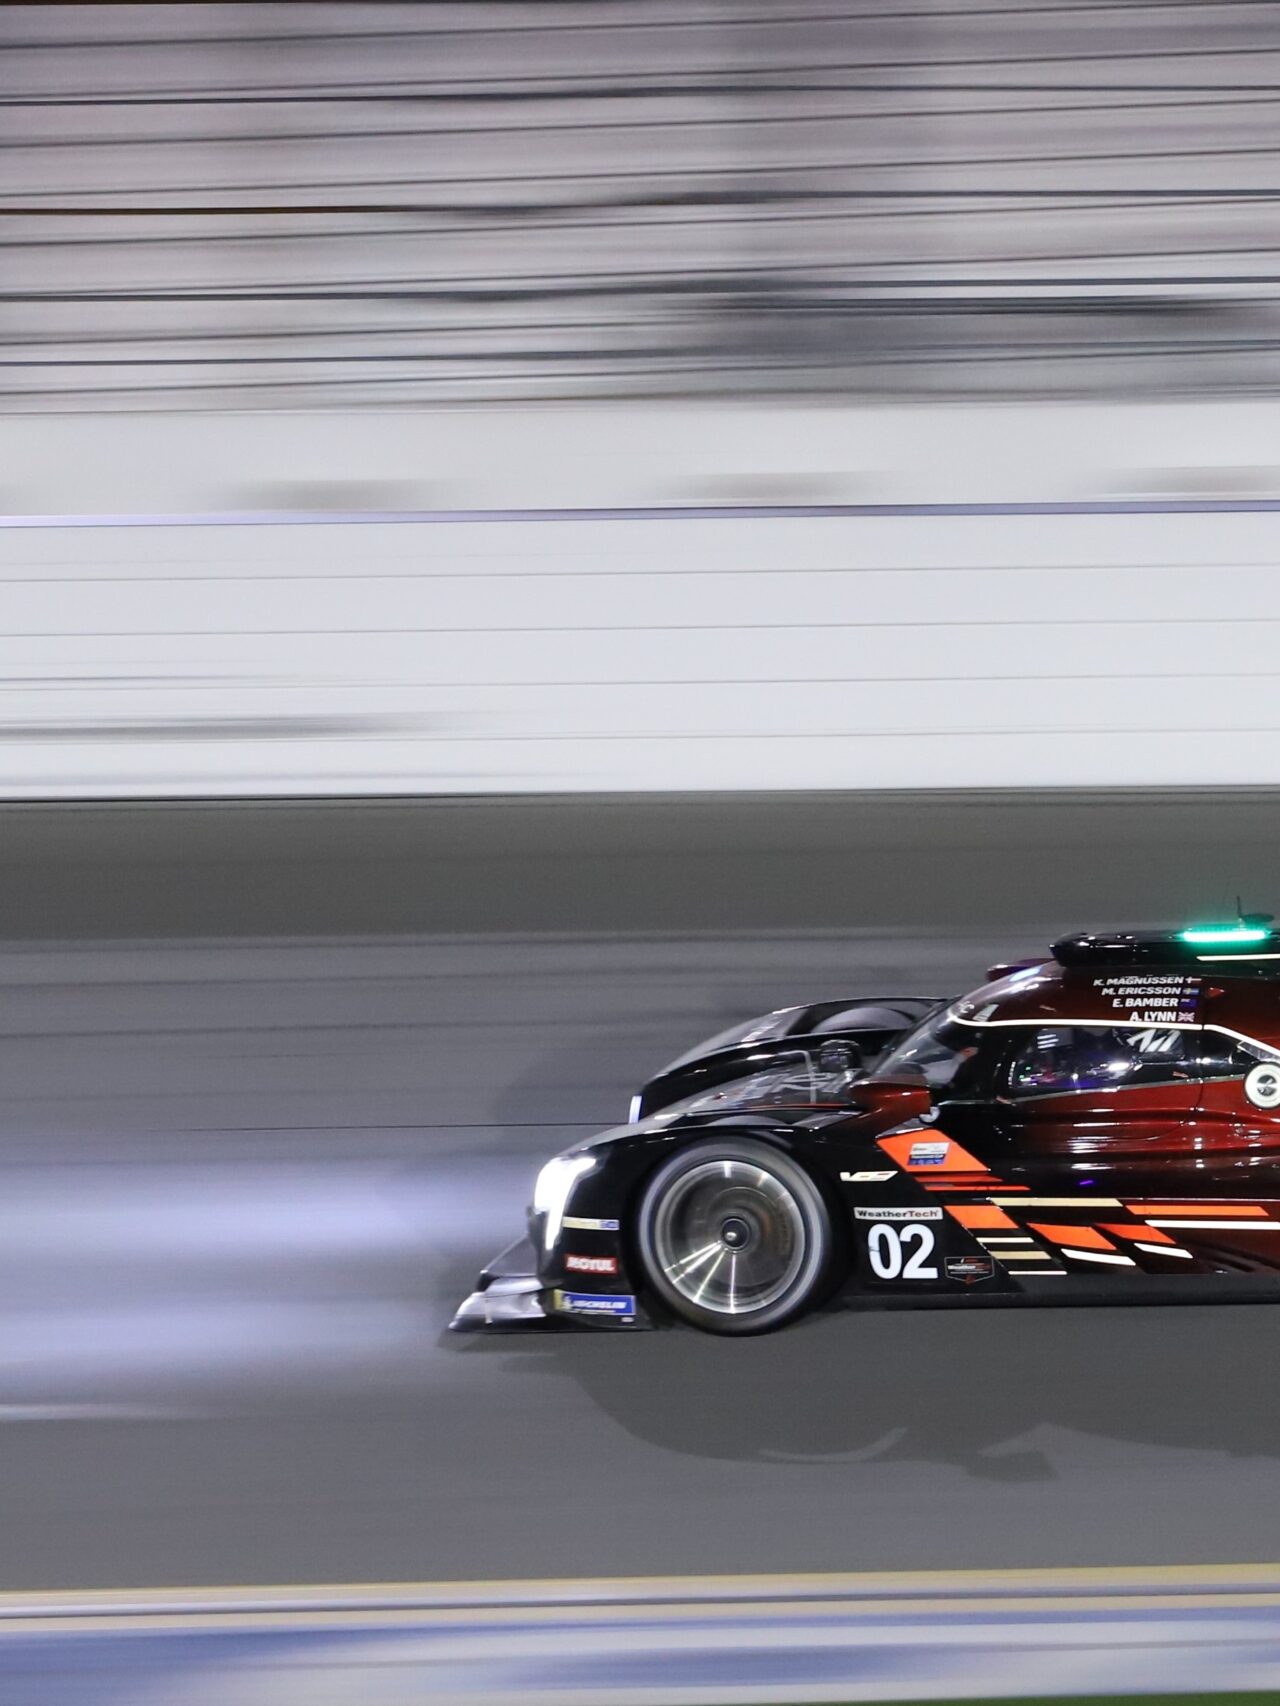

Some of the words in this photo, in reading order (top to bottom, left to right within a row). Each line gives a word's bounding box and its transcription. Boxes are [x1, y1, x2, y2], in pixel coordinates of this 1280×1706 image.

[1106, 976, 1184, 986] MAGNUSSEN
[1101, 987, 1116, 996] M.
[1118, 987, 1182, 996] ERICSSON
[1112, 998, 1124, 1008] E.
[1125, 998, 1179, 1008] BAMBER
[1130, 1011, 1143, 1022] A.
[1144, 1011, 1177, 1022] LYNN
[856, 1209, 939, 1218] WeatherTech
[867, 1223, 939, 1280] 02
